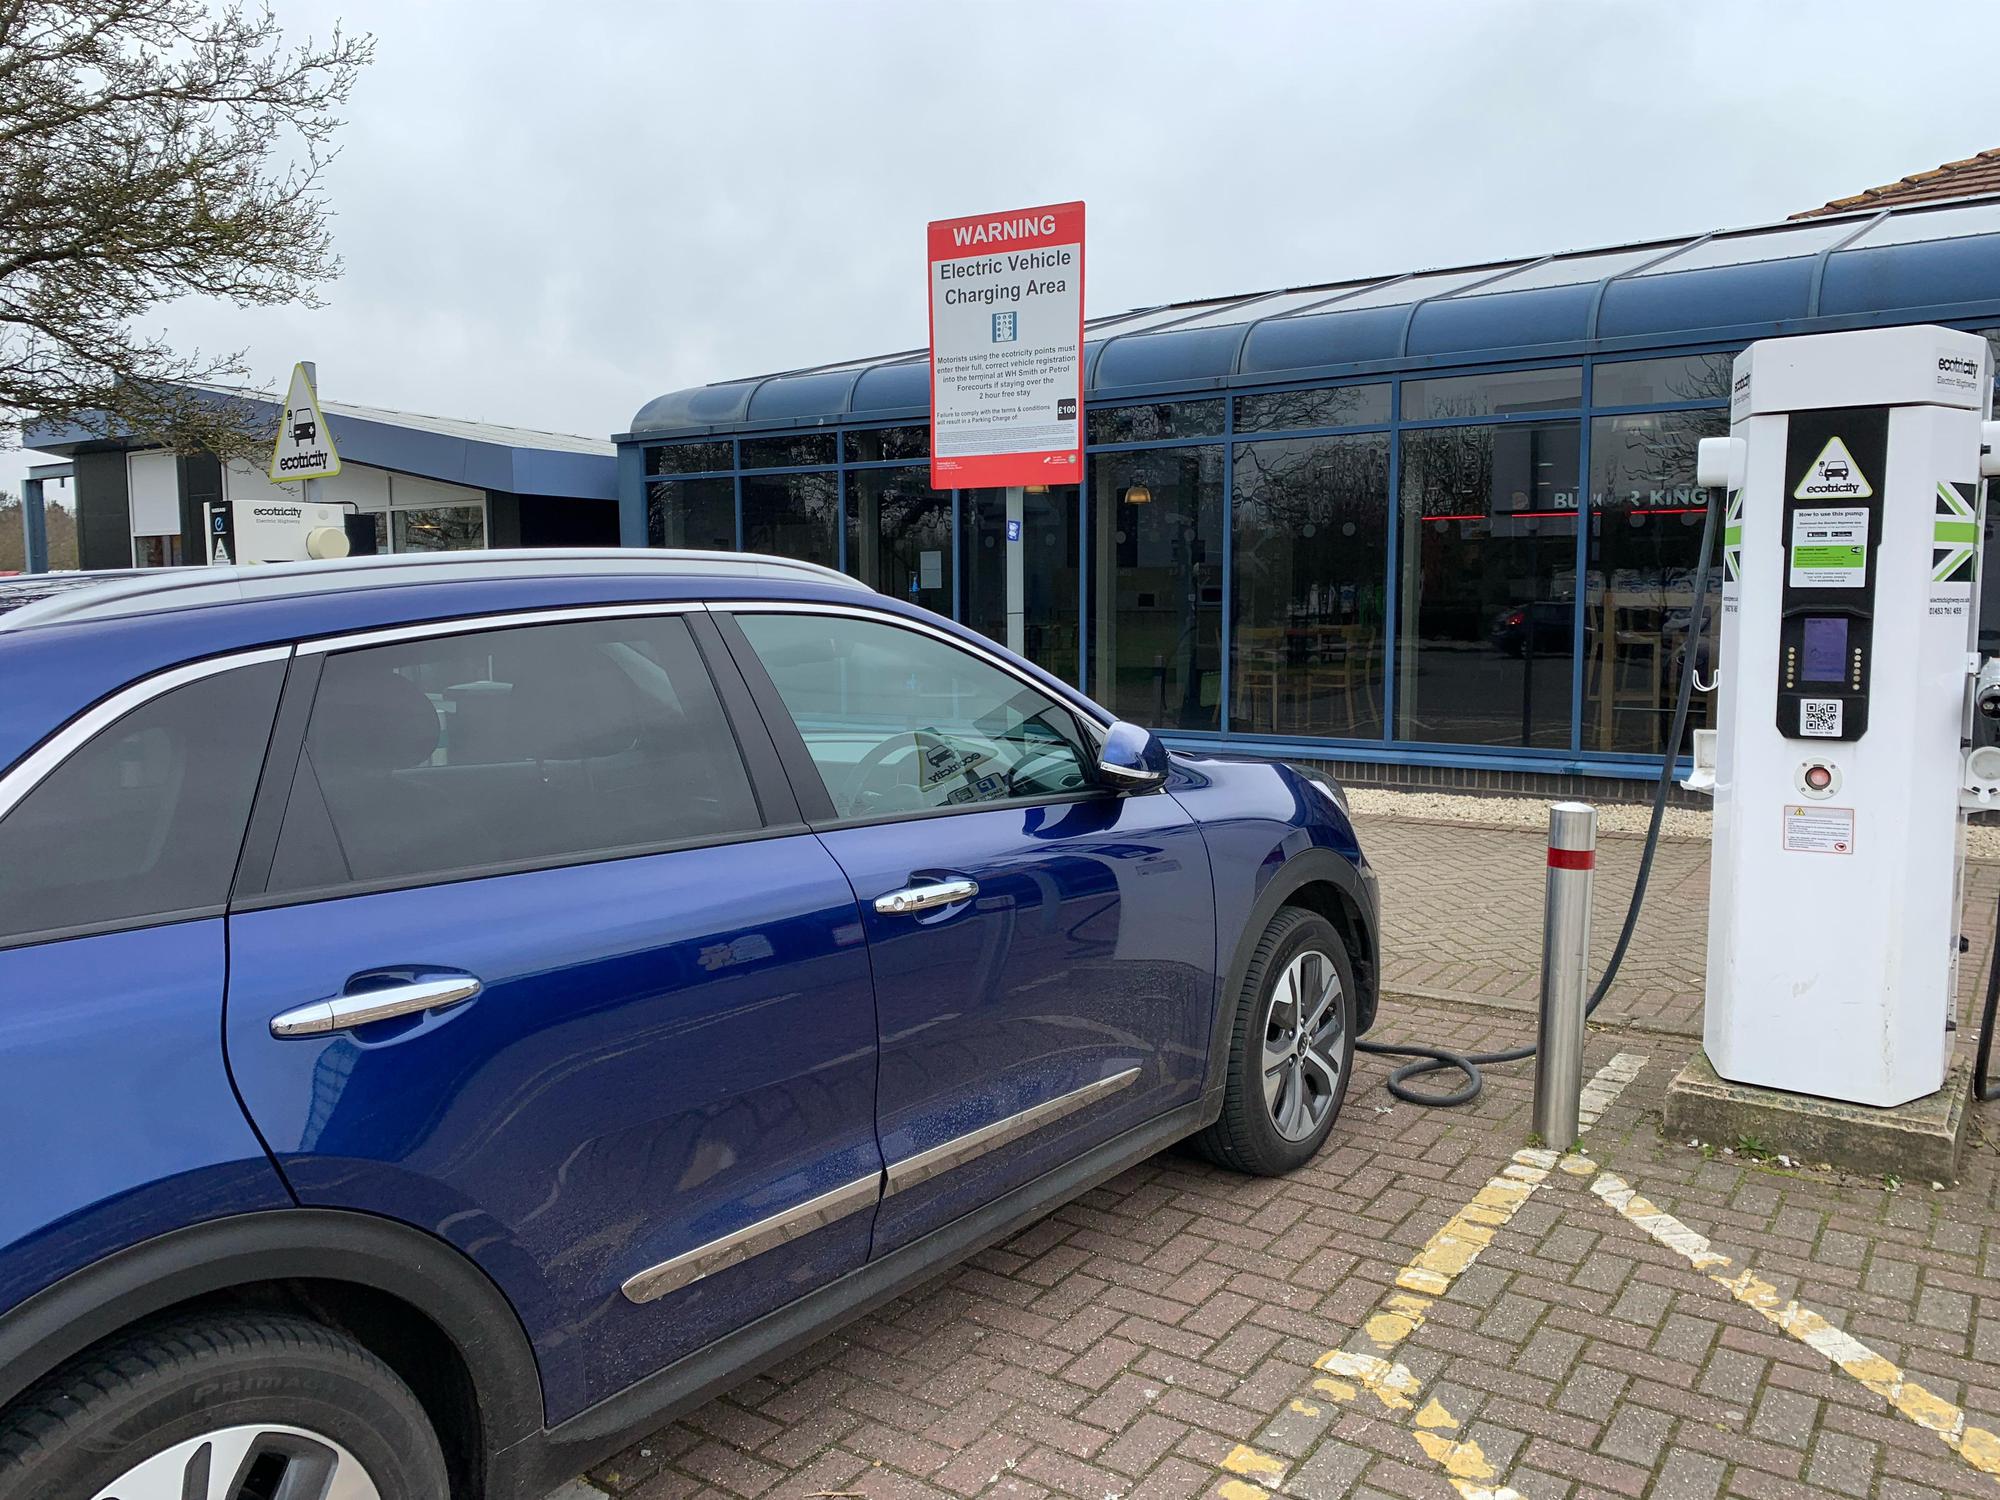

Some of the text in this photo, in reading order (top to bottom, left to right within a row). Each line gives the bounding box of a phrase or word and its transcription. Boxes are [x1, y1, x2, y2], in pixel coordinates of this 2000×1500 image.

[953, 215, 1056, 246] WARNING
[941, 250, 1071, 280] Electric Vehicle
[945, 280, 1066, 305] Charging Area
[937, 355, 967, 364] Motorists
[970, 354, 988, 362] using
[1002, 349, 1032, 358] ecotricity
[1034, 346, 1056, 356] points
[986, 361, 1009, 370] correct
[1036, 355, 1075, 366] registration
[1938, 357, 1978, 379] ecotricity
[969, 372, 995, 381] terminal
[1937, 376, 1956, 386] Electric
[957, 383, 992, 392] Forecourts
[1000, 380, 1024, 388] staying
[937, 410, 954, 418] Failure
[962, 408, 979, 418] comply
[1058, 405, 1075, 414] £100
[972, 415, 991, 424] Parking
[280, 450, 328, 471] ecotricity
[1806, 482, 1860, 494] ecotricity
[1650, 488, 1708, 505] KING
[254, 506, 302, 518] ecotricity
